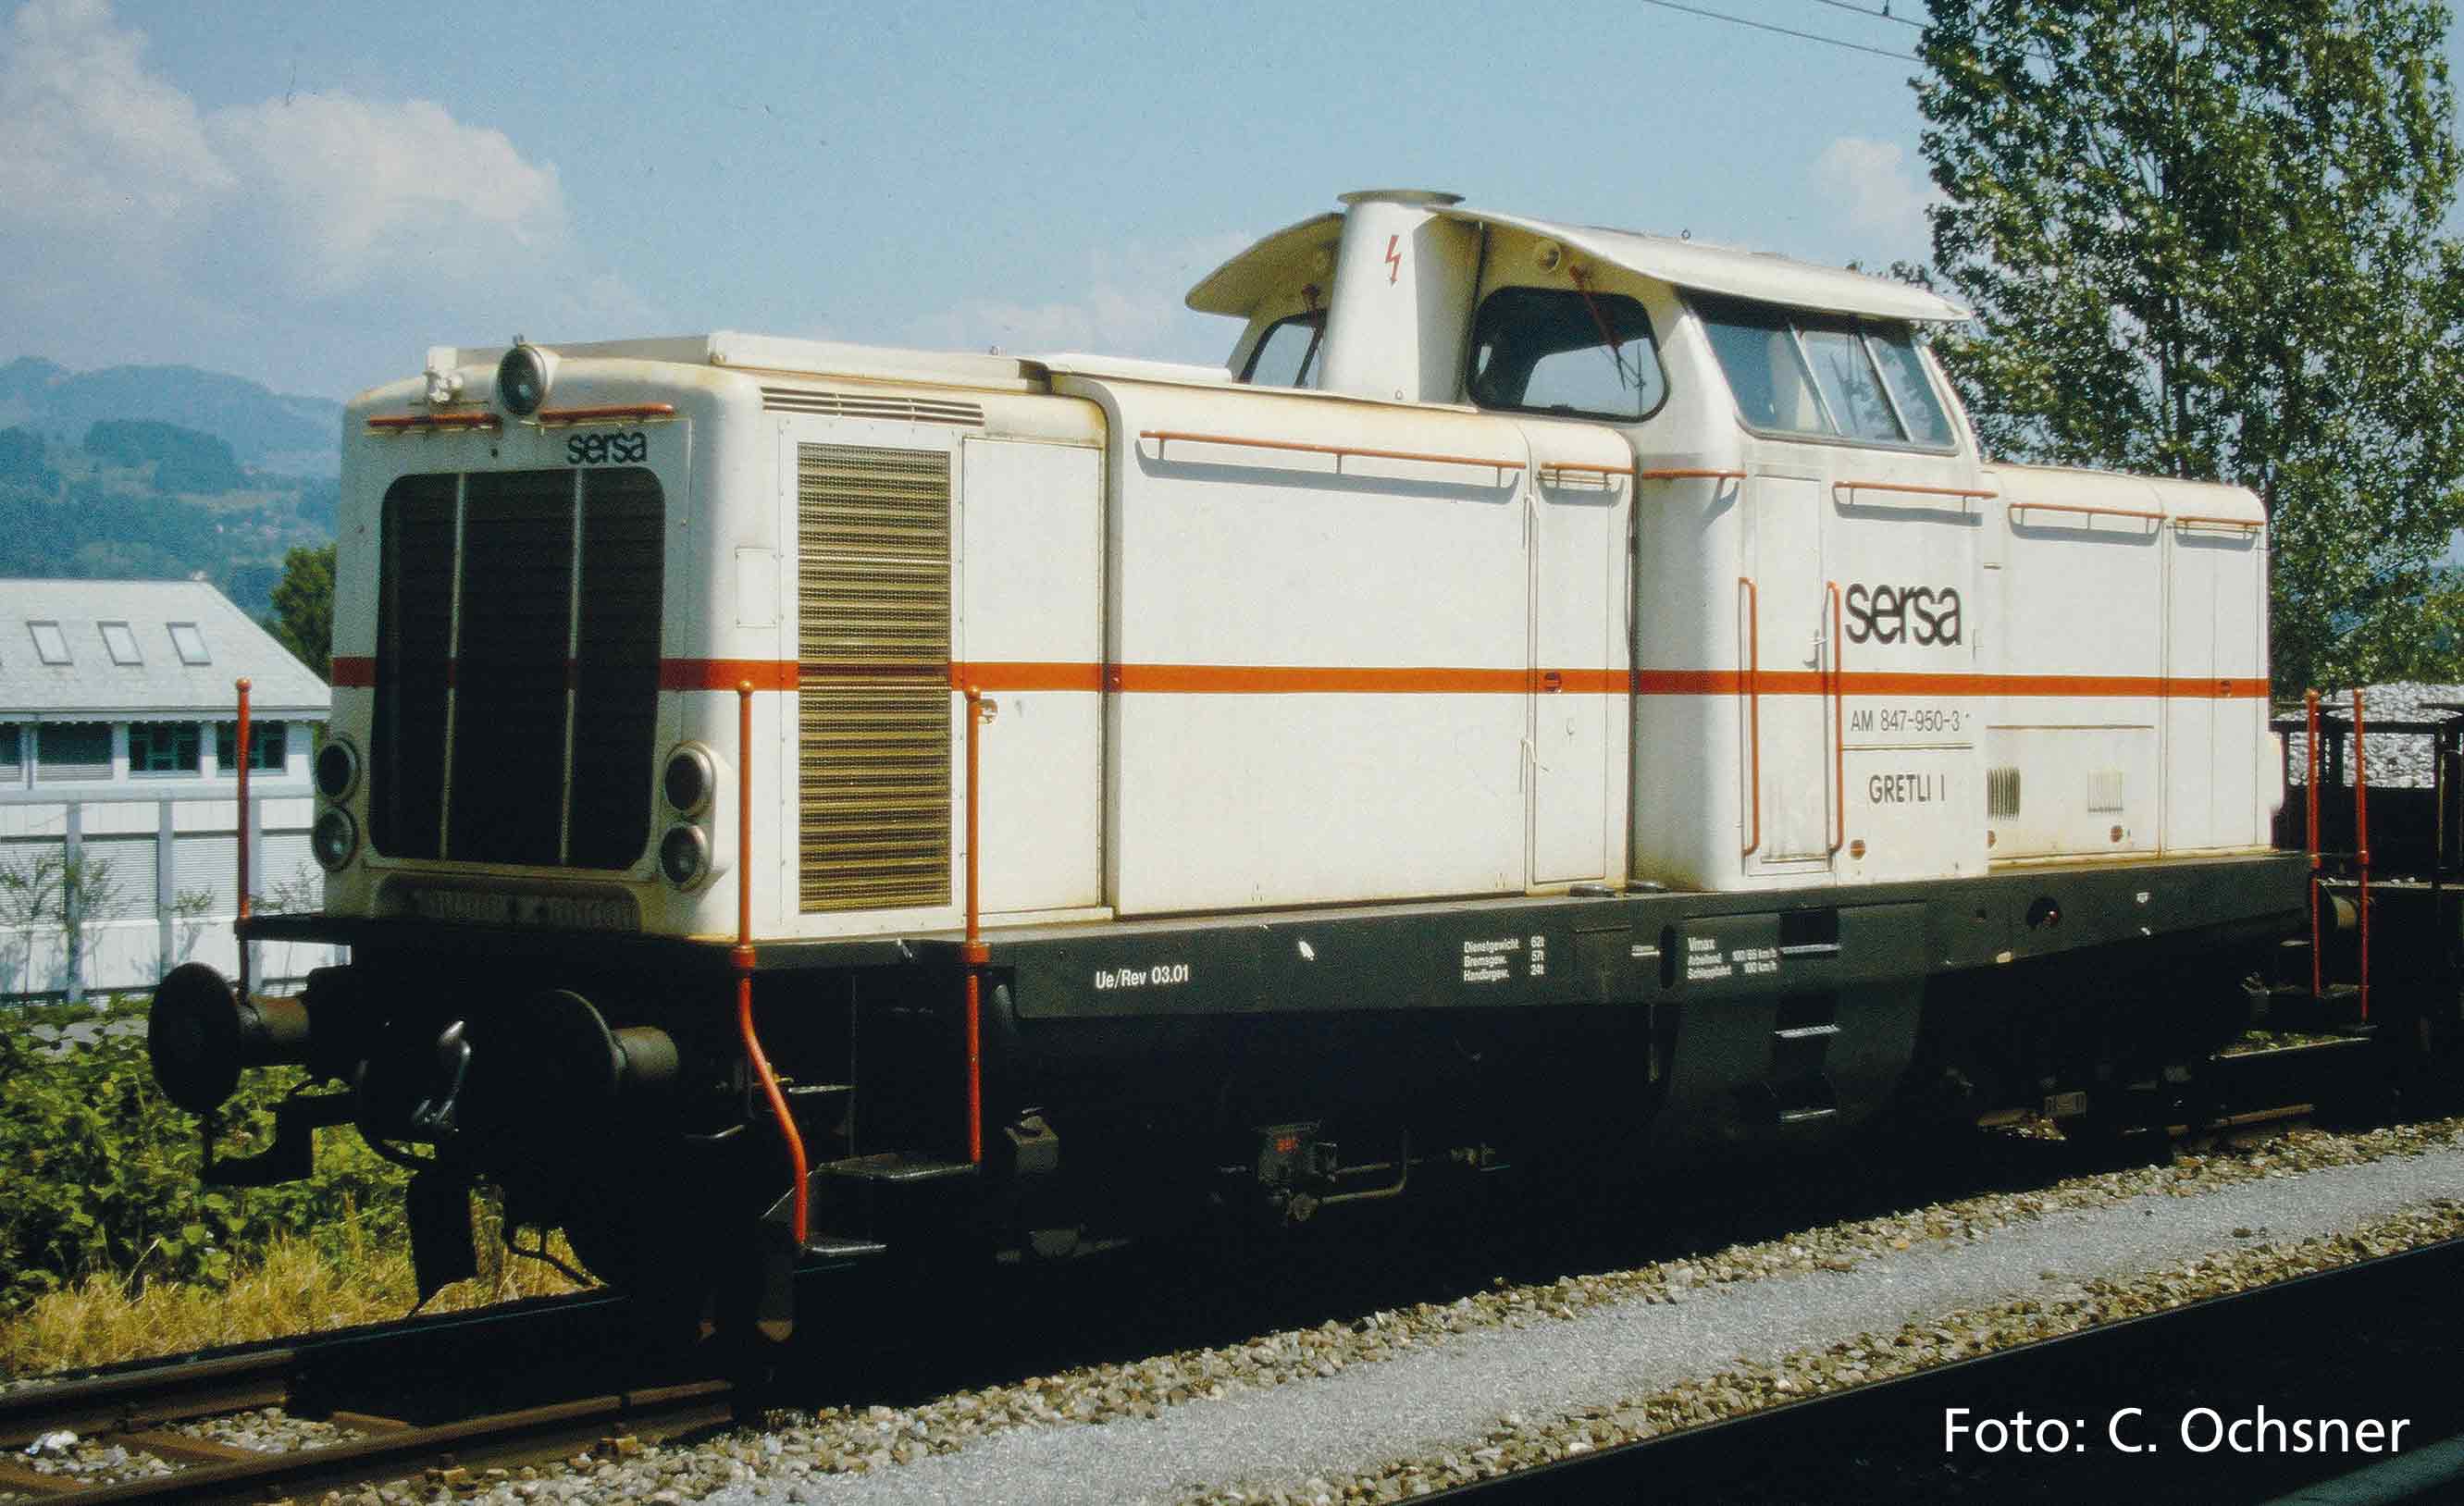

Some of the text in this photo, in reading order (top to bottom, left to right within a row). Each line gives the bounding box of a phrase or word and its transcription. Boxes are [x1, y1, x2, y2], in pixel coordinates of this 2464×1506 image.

[567, 432, 648, 464] sersa
[1845, 583, 1963, 647] sersa
[1851, 710, 1961, 733] AM 847-950-3
[1869, 773, 1931, 803] GRETLI
[1687, 937, 1716, 951] Vmax
[1095, 964, 1190, 990] Ue/Rev 03.01
